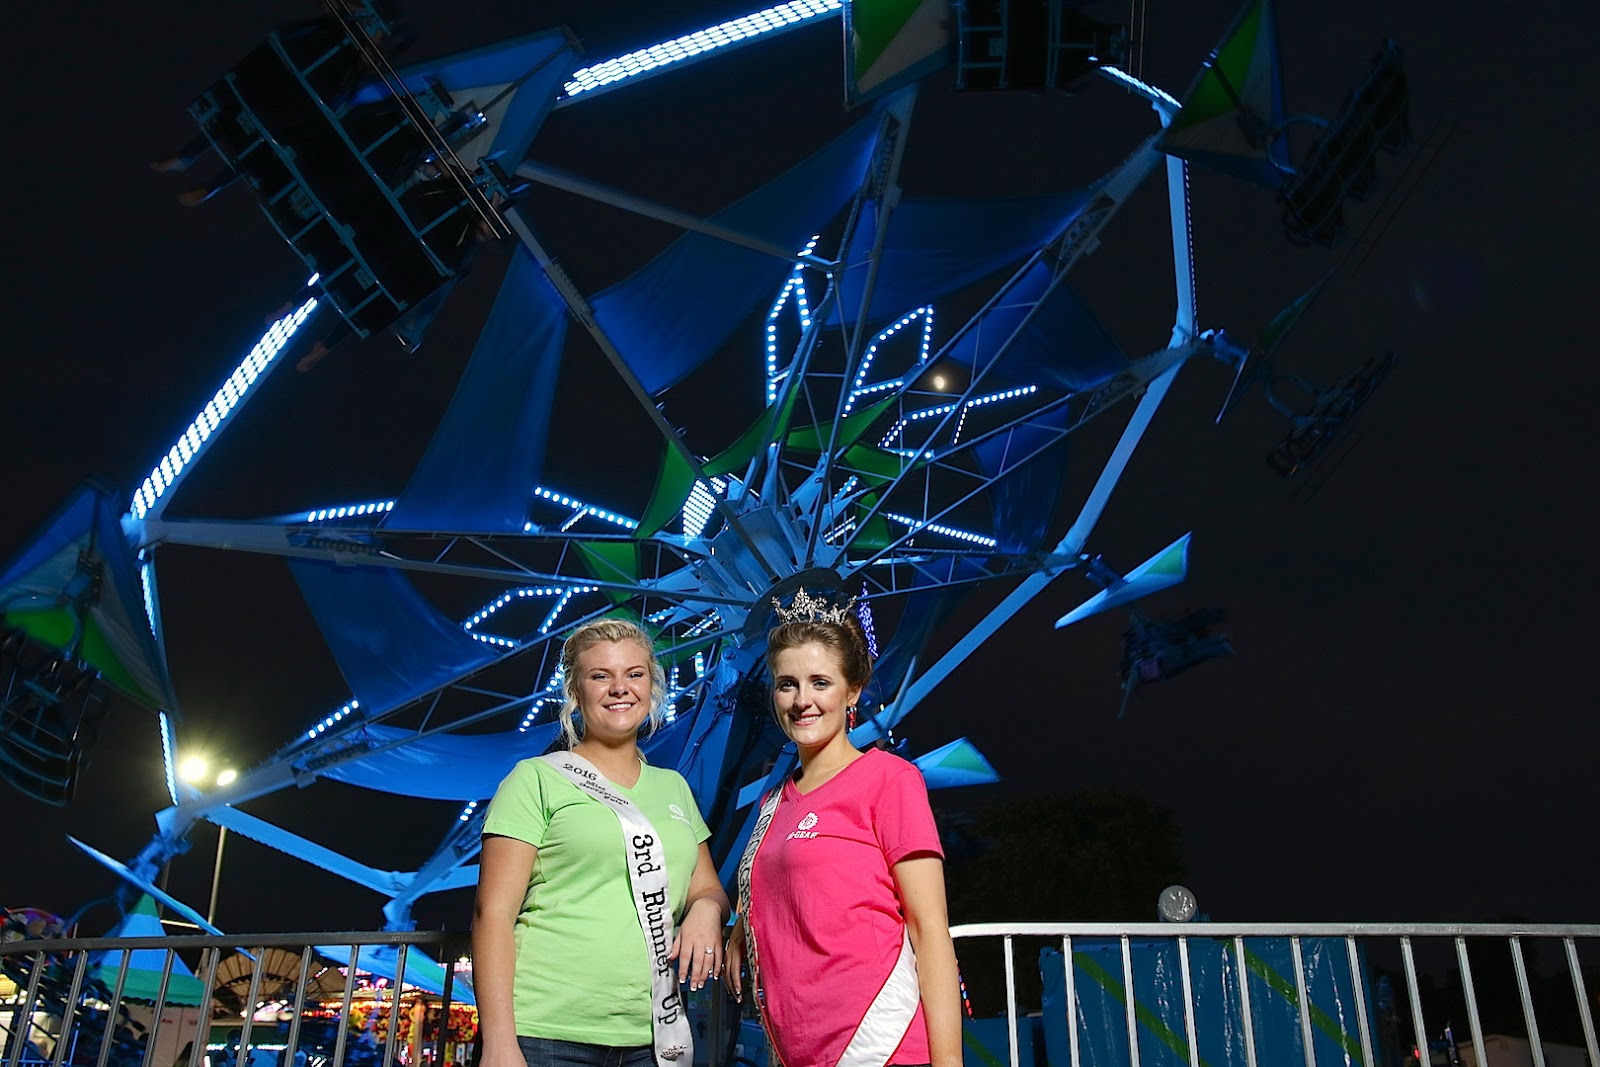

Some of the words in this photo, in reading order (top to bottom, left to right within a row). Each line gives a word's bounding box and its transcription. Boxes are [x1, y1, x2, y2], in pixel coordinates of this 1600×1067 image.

[562, 763, 598, 781] 2016
[632, 834, 662, 877] 3rd
[642, 887, 671, 978] Runner
[658, 987, 682, 1026] Up
